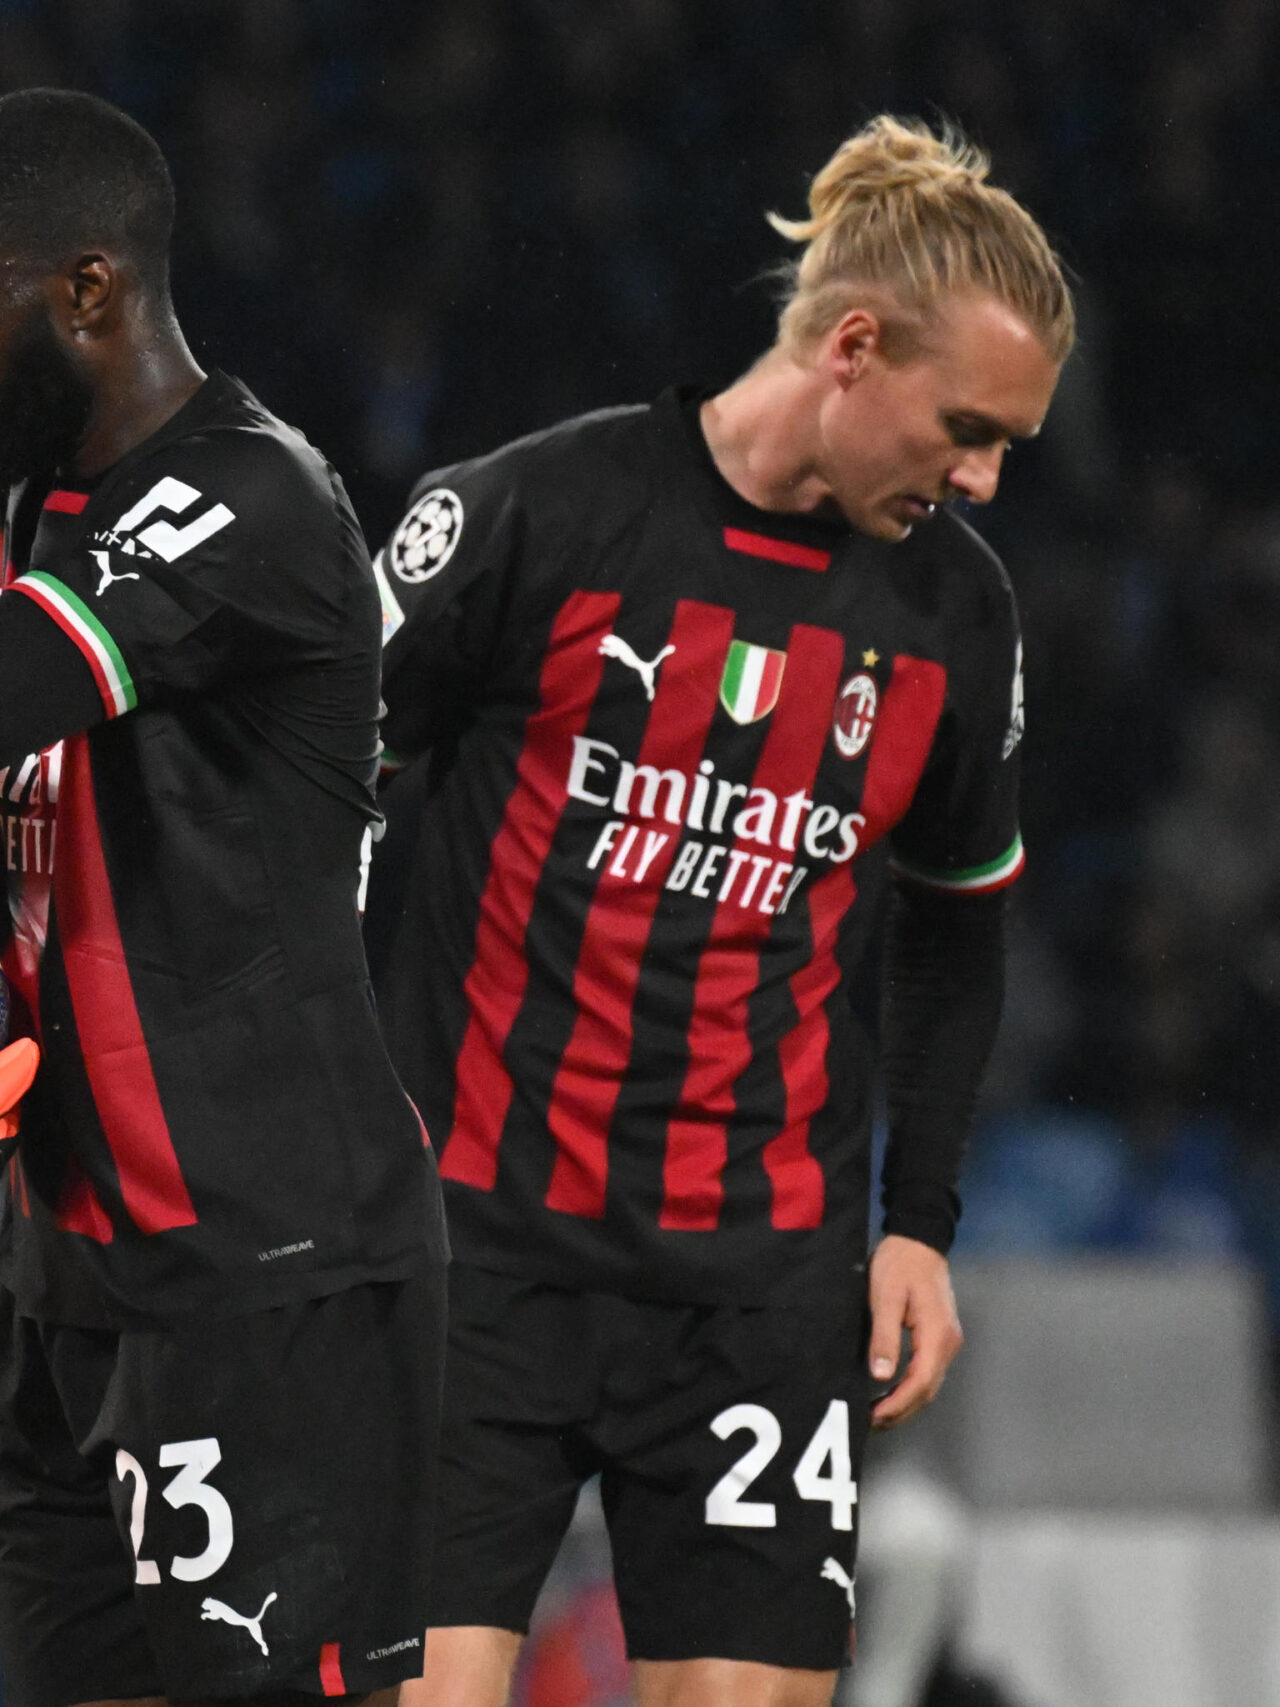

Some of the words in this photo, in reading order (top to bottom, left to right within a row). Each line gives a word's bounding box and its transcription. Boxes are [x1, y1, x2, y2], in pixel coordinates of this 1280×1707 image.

[566, 735, 867, 864] Emirates
[586, 820, 670, 884] FLY
[665, 840, 809, 915] BETTER
[115, 1437, 234, 1585] 23
[705, 1398, 858, 1532] 24
